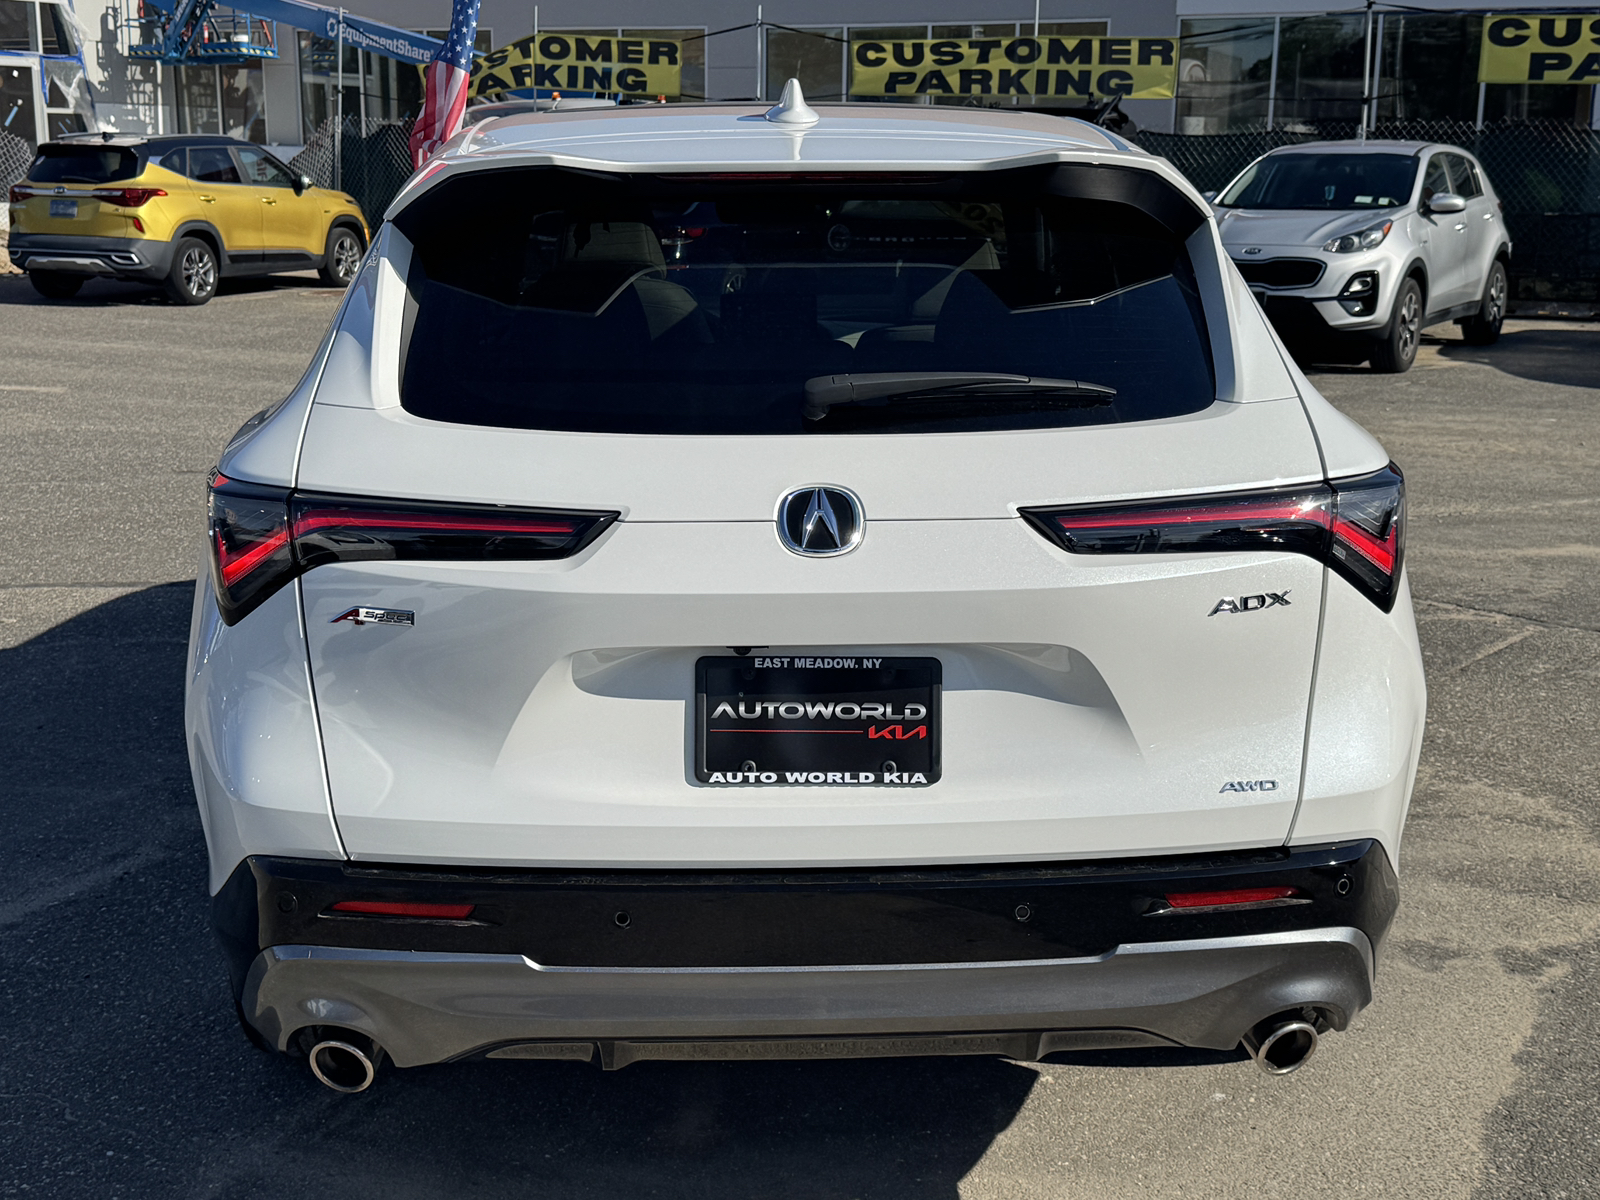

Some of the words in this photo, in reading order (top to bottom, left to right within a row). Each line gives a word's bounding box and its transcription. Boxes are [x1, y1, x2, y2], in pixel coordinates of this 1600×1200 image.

[340, 22, 432, 62] EquipmentShare
[1487, 17, 1600, 48] CU
[423, 36, 679, 80] STOMER
[856, 38, 1175, 67] CUSTOMER
[468, 63, 648, 96] ARKING
[885, 69, 1134, 96] PARKING
[1207, 589, 1292, 617] ADX
[754, 657, 790, 668] EAST
[794, 657, 859, 669] MEADOW,
[863, 657, 882, 669] NY
[711, 701, 927, 720] AUTOWORLD
[708, 772, 778, 784] AUTO
[785, 772, 875, 784] WORLD
[884, 772, 928, 784] KIA
[1219, 779, 1279, 794] AWD
